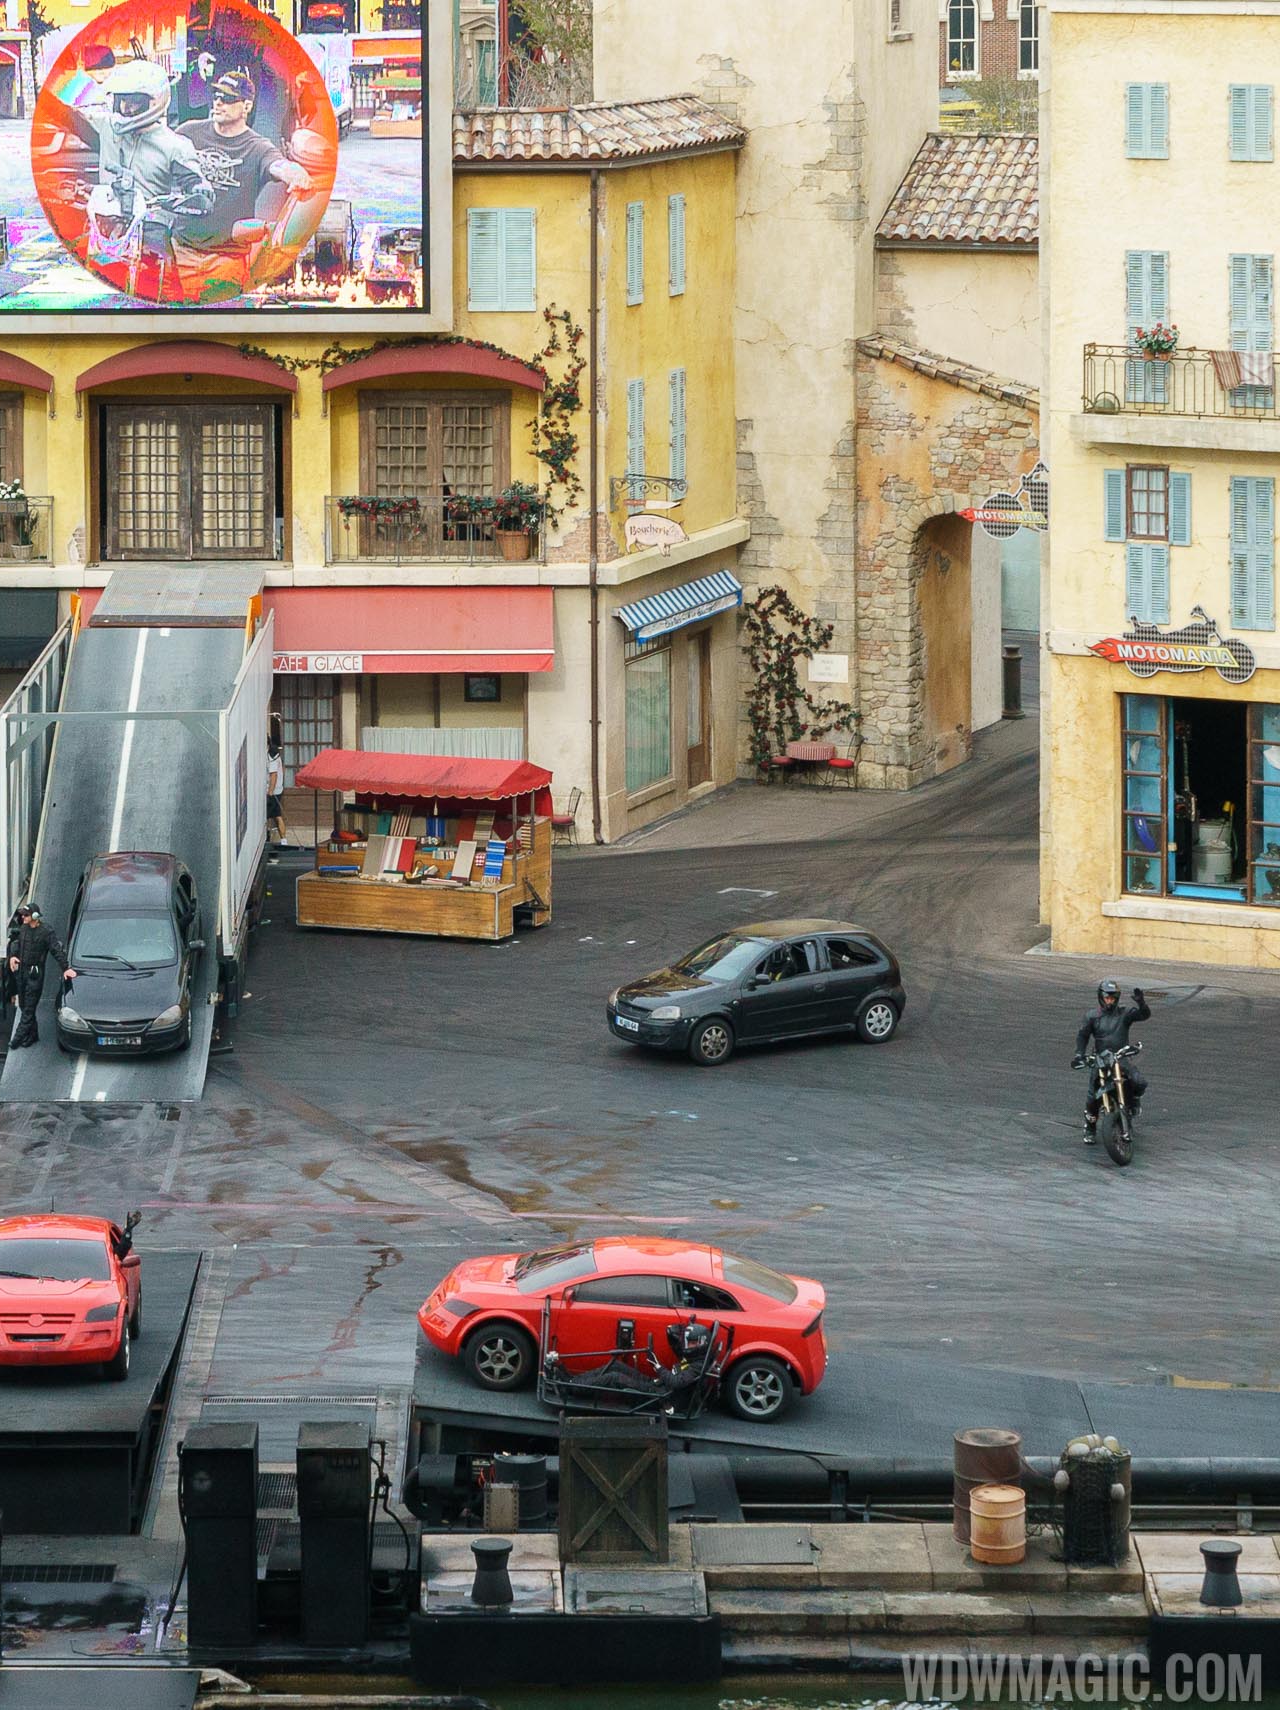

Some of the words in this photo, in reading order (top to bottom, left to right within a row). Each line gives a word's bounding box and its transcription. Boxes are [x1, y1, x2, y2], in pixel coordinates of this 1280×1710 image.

[629, 524, 670, 536] Boucherie
[1117, 643, 1235, 665] MOTOMANIA
[314, 656, 359, 671] GLACE
